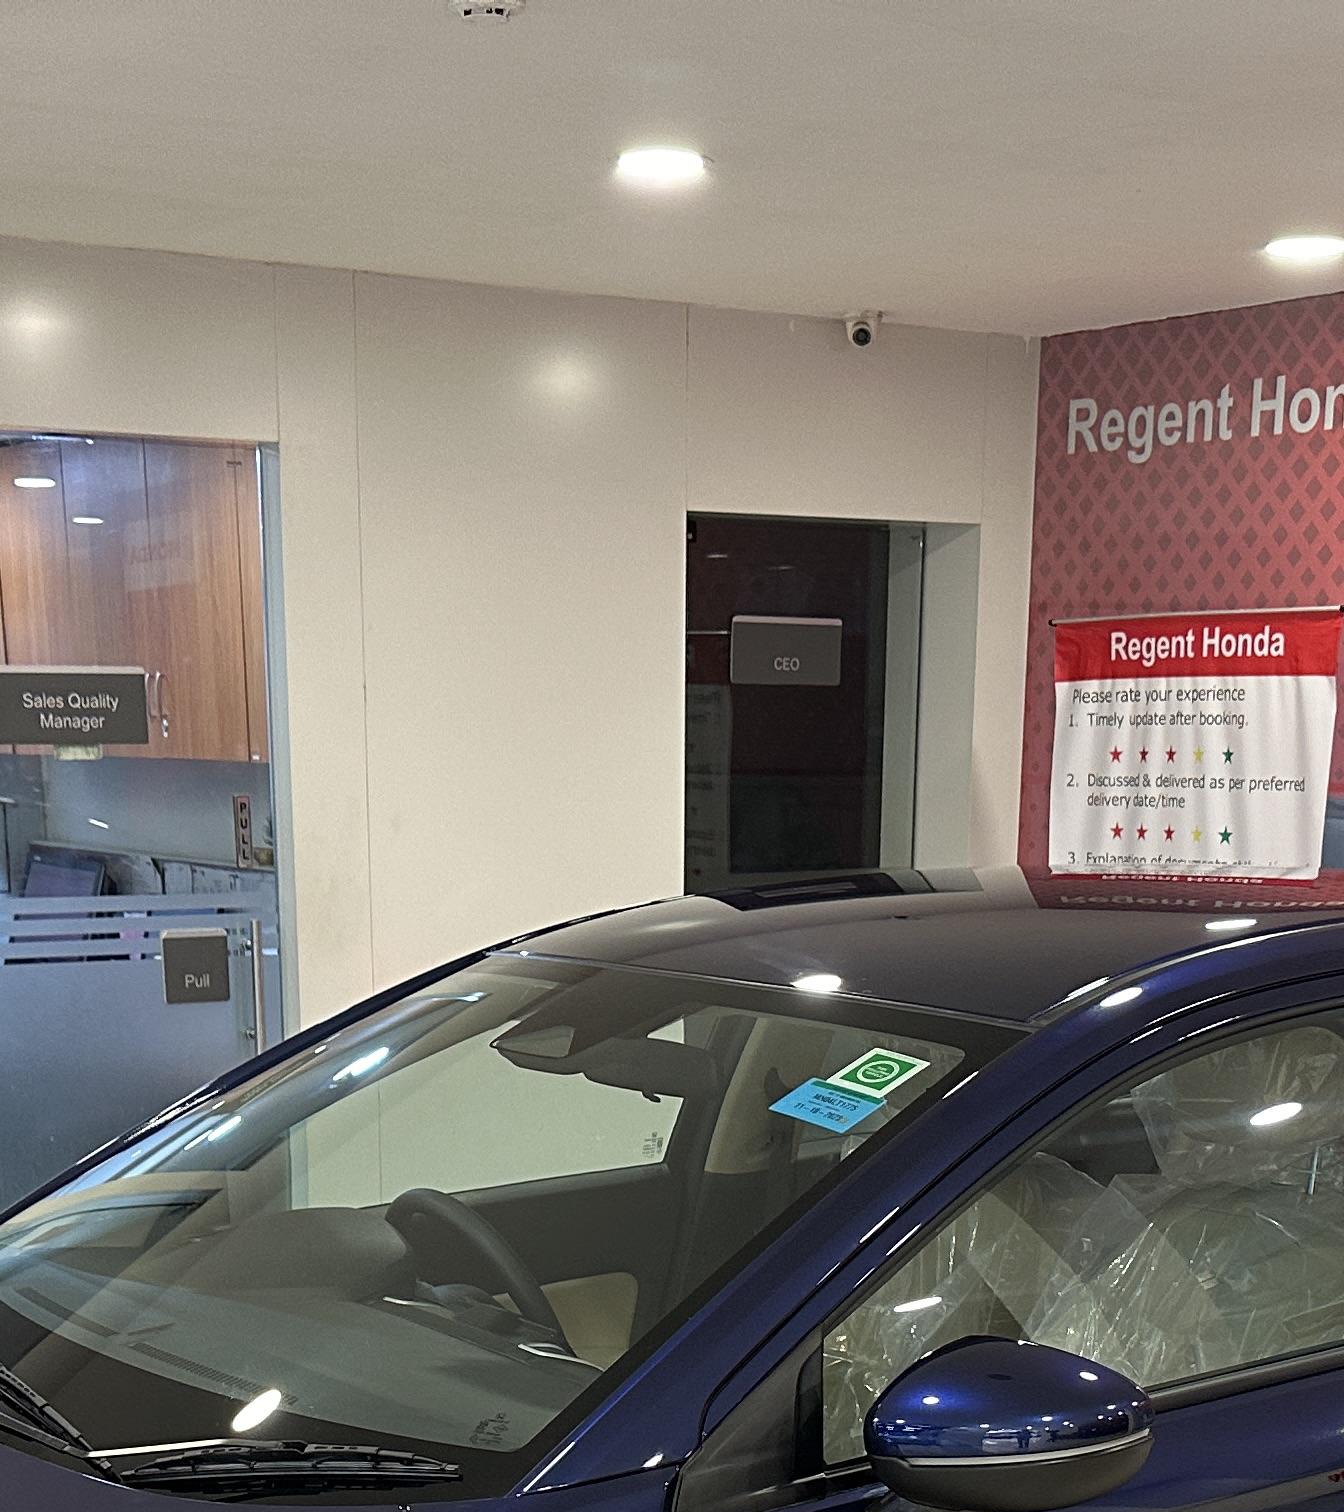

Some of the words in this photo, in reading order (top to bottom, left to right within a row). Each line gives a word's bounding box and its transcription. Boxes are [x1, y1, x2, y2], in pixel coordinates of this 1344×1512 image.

[1067, 383, 1234, 464] Regent
[1110, 628, 1195, 668] Regent
[1202, 625, 1284, 657] Honda
[774, 657, 800, 671] CEO
[22, 692, 64, 709] Sales
[68, 692, 118, 712] Quality
[1072, 689, 1112, 704] Please
[1116, 690, 1141, 702] rate
[1144, 690, 1172, 705] your
[1176, 687, 1245, 703] experience
[40, 712, 106, 732] Manager
[1068, 714, 1078, 727] 1.
[1087, 713, 1124, 728] Timely
[1129, 712, 1166, 727] update
[1169, 712, 1196, 726] after
[1199, 712, 1248, 729] booking.
[1067, 774, 1079, 787] 2.
[1087, 773, 1140, 787] Discussed
[1143, 774, 1151, 787] &
[1156, 774, 1204, 788] delivered
[1209, 780, 1225, 788] as
[1229, 779, 1245, 790] per
[1248, 777, 1305, 793] preferred
[1087, 792, 1131, 809] delivery
[1133, 792, 1185, 808] date/time
[240, 802, 250, 860] PULL
[184, 974, 210, 988] Pull
